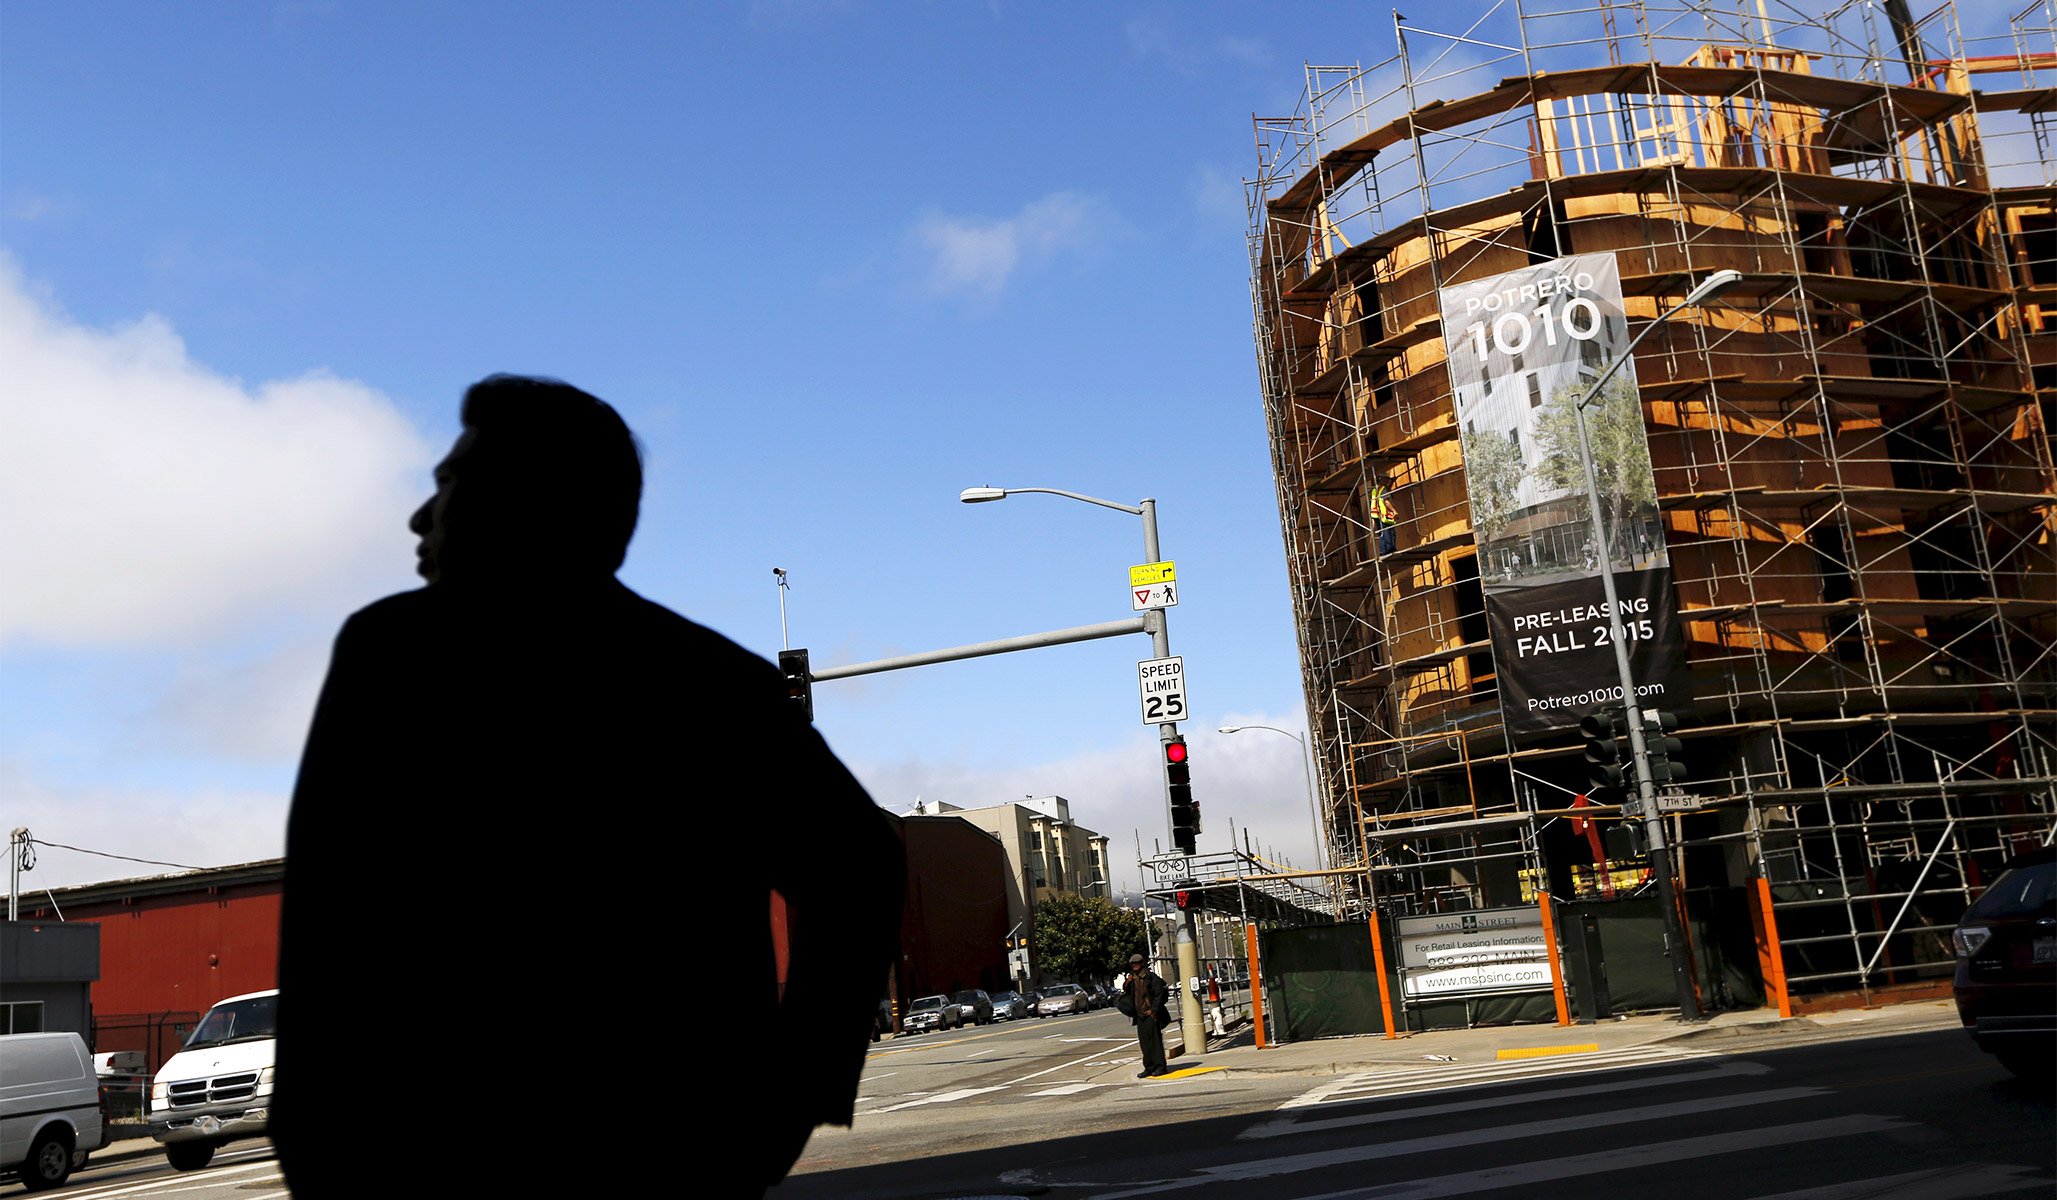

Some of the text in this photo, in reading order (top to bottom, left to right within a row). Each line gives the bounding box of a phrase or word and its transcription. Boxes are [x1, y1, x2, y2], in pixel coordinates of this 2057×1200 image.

[1465, 272, 1594, 316] POTRERO
[1466, 297, 1601, 362] 1010
[1133, 566, 1160, 575] TURNING
[1134, 575, 1161, 583] VEHICLES
[1514, 598, 1649, 631] PRE-LEASNG
[1517, 630, 1585, 658] FALL
[1141, 663, 1181, 678] SPEED
[1145, 678, 1178, 693] LIMIT
[1528, 683, 1665, 711] Potrero1010om
[1146, 694, 1183, 718] 25
[1664, 797, 1692, 807] 7TH ST
[1436, 917, 1517, 930] MAIN STREET
[1415, 935, 1544, 952] For Retail Leasing Information:
[1426, 970, 1543, 987] www.mspsinc.com
